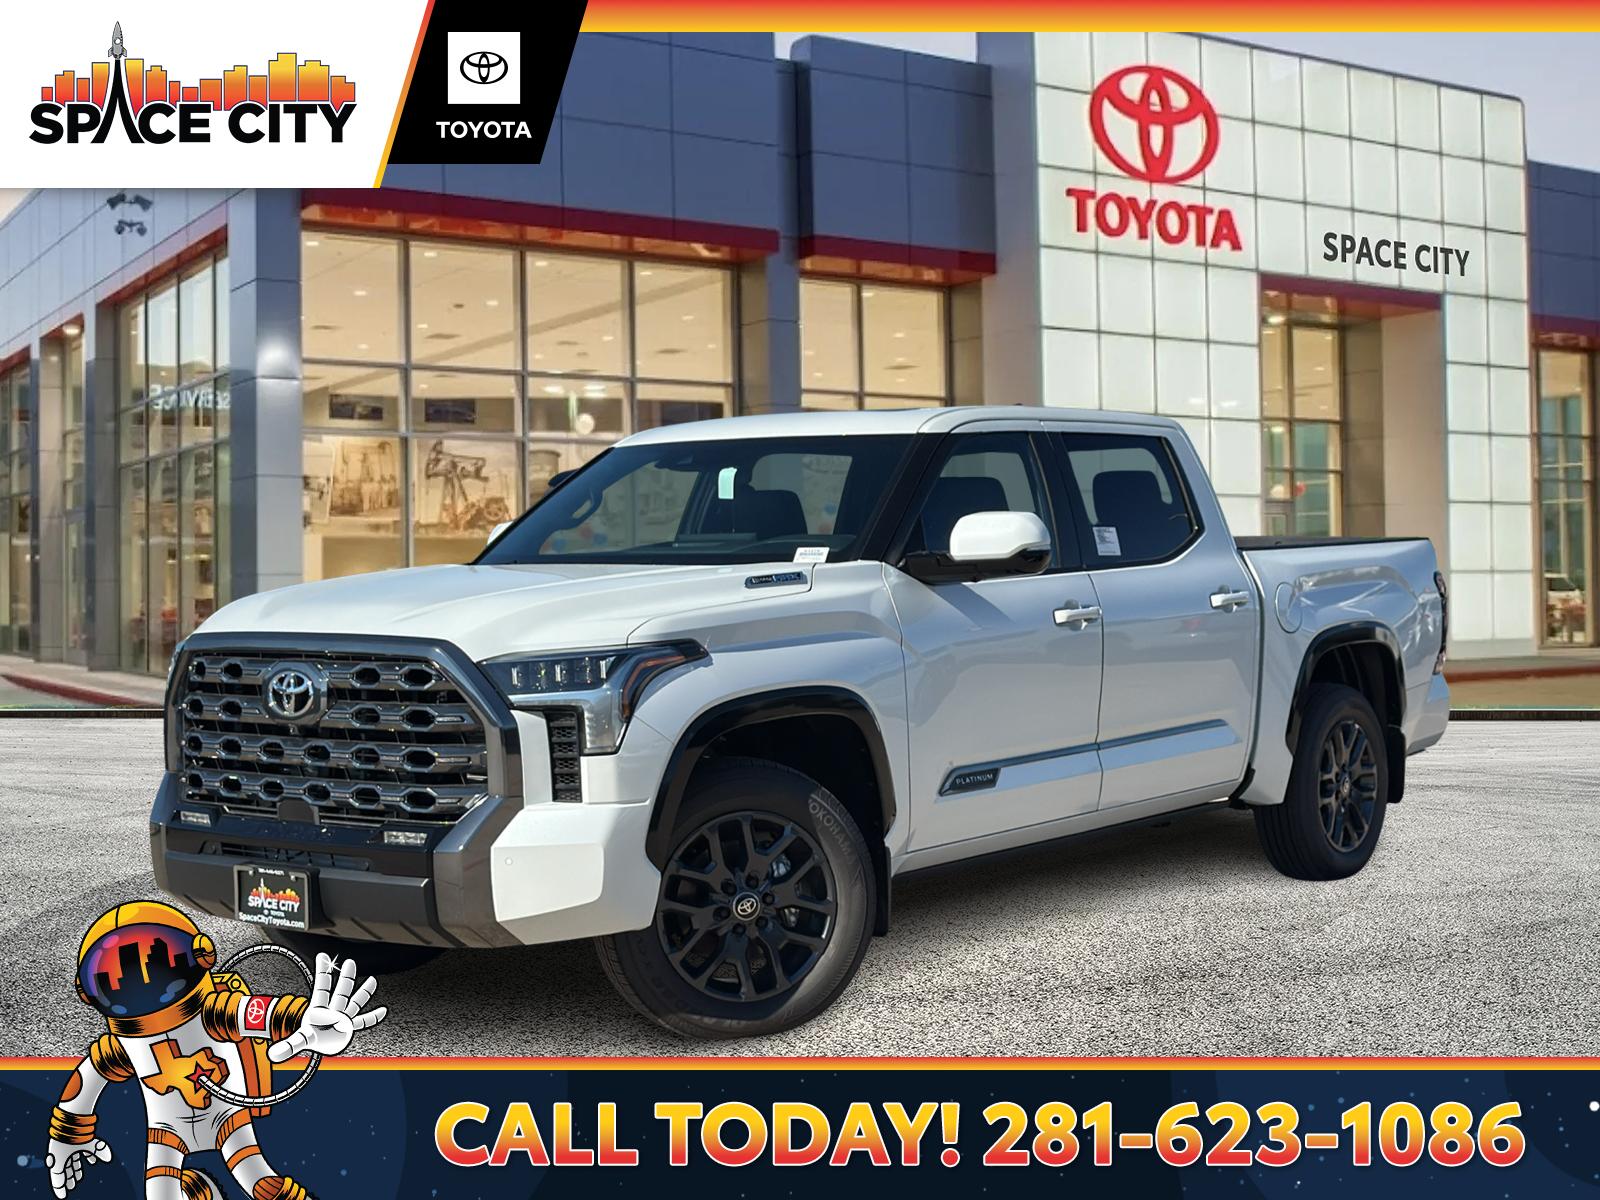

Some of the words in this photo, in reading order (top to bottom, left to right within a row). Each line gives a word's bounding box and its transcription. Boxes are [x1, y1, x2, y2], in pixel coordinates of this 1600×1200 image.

[1065, 187, 1243, 252] TOYOTA
[1322, 231, 1407, 270] SPACE
[1414, 243, 1470, 277] CITY
[955, 773, 993, 784] PLATINUM
[808, 798, 857, 866] OKOHAMA
[247, 894, 278, 910] SPACE
[279, 899, 300, 912] CITY
[239, 912, 305, 928] SpaceCityToyota.com
